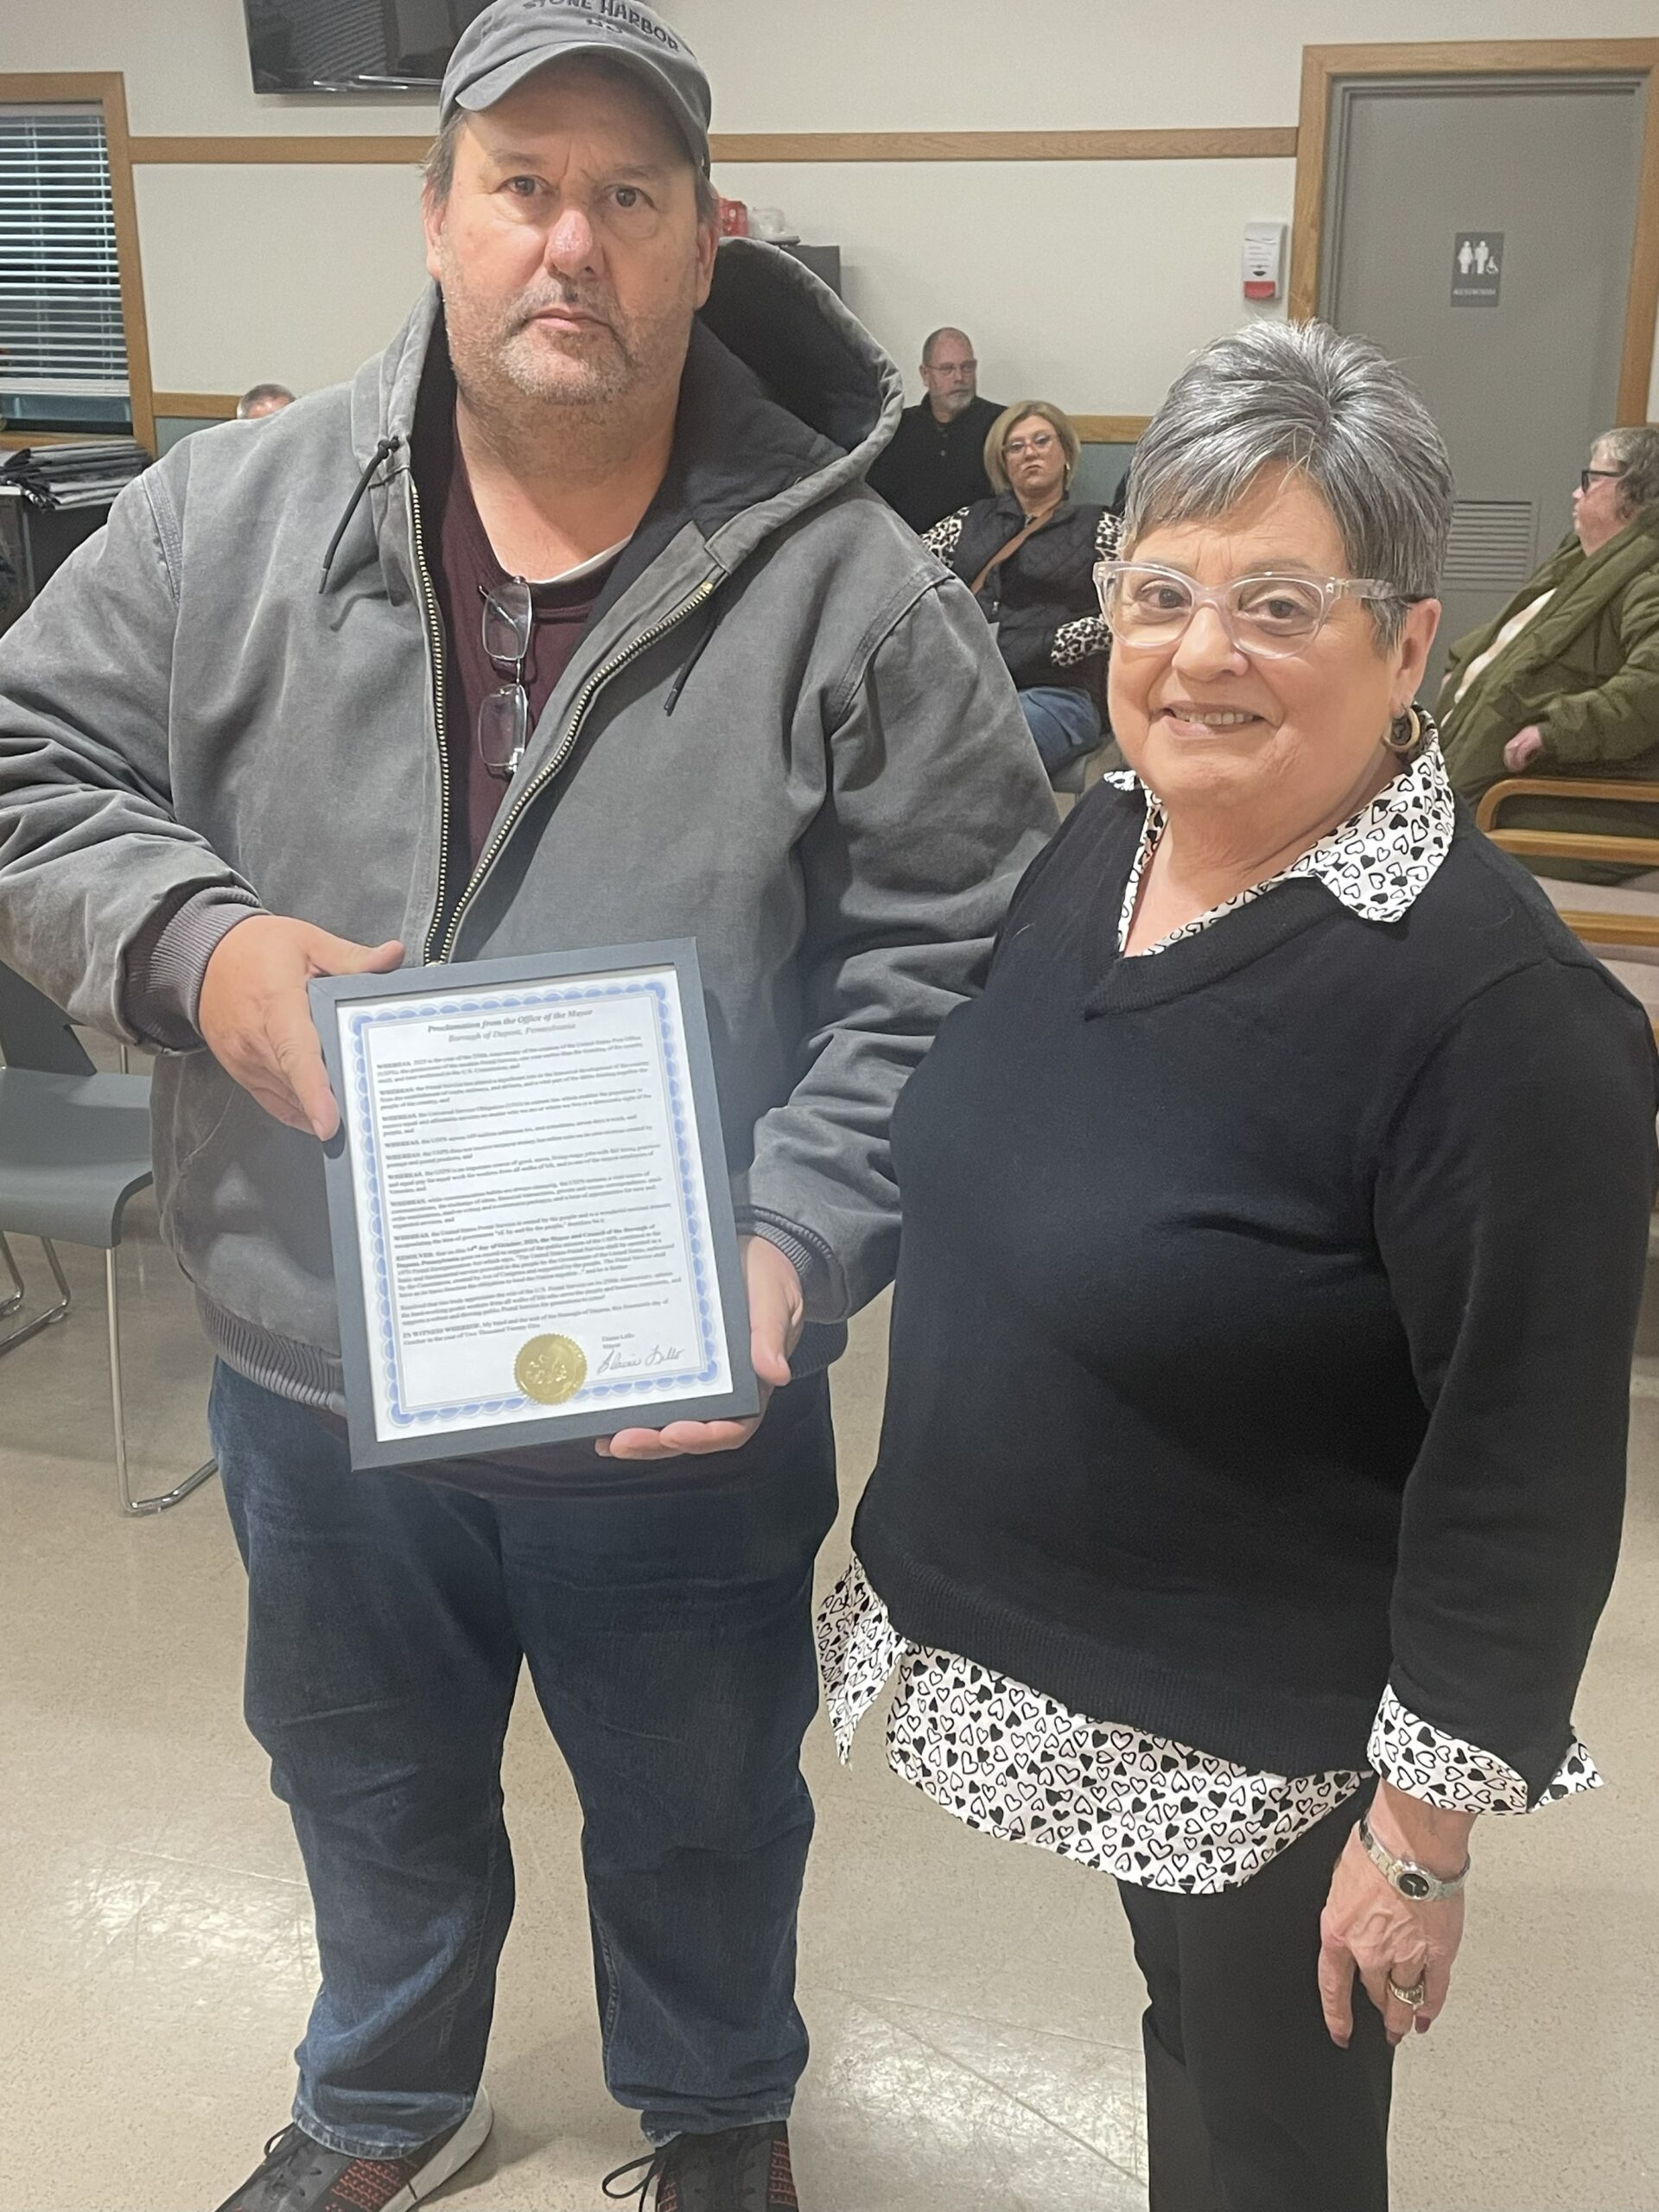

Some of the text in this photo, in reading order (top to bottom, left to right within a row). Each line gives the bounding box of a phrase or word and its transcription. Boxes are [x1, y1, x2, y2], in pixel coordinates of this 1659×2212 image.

[600, 0, 679, 51] HARBOR
[480, 1018, 502, 1028] from
[518, 1014, 541, 1024] Office
[543, 1013, 552, 1021] of
[568, 1007, 593, 1018] Mayor
[483, 1031, 492, 1039] of
